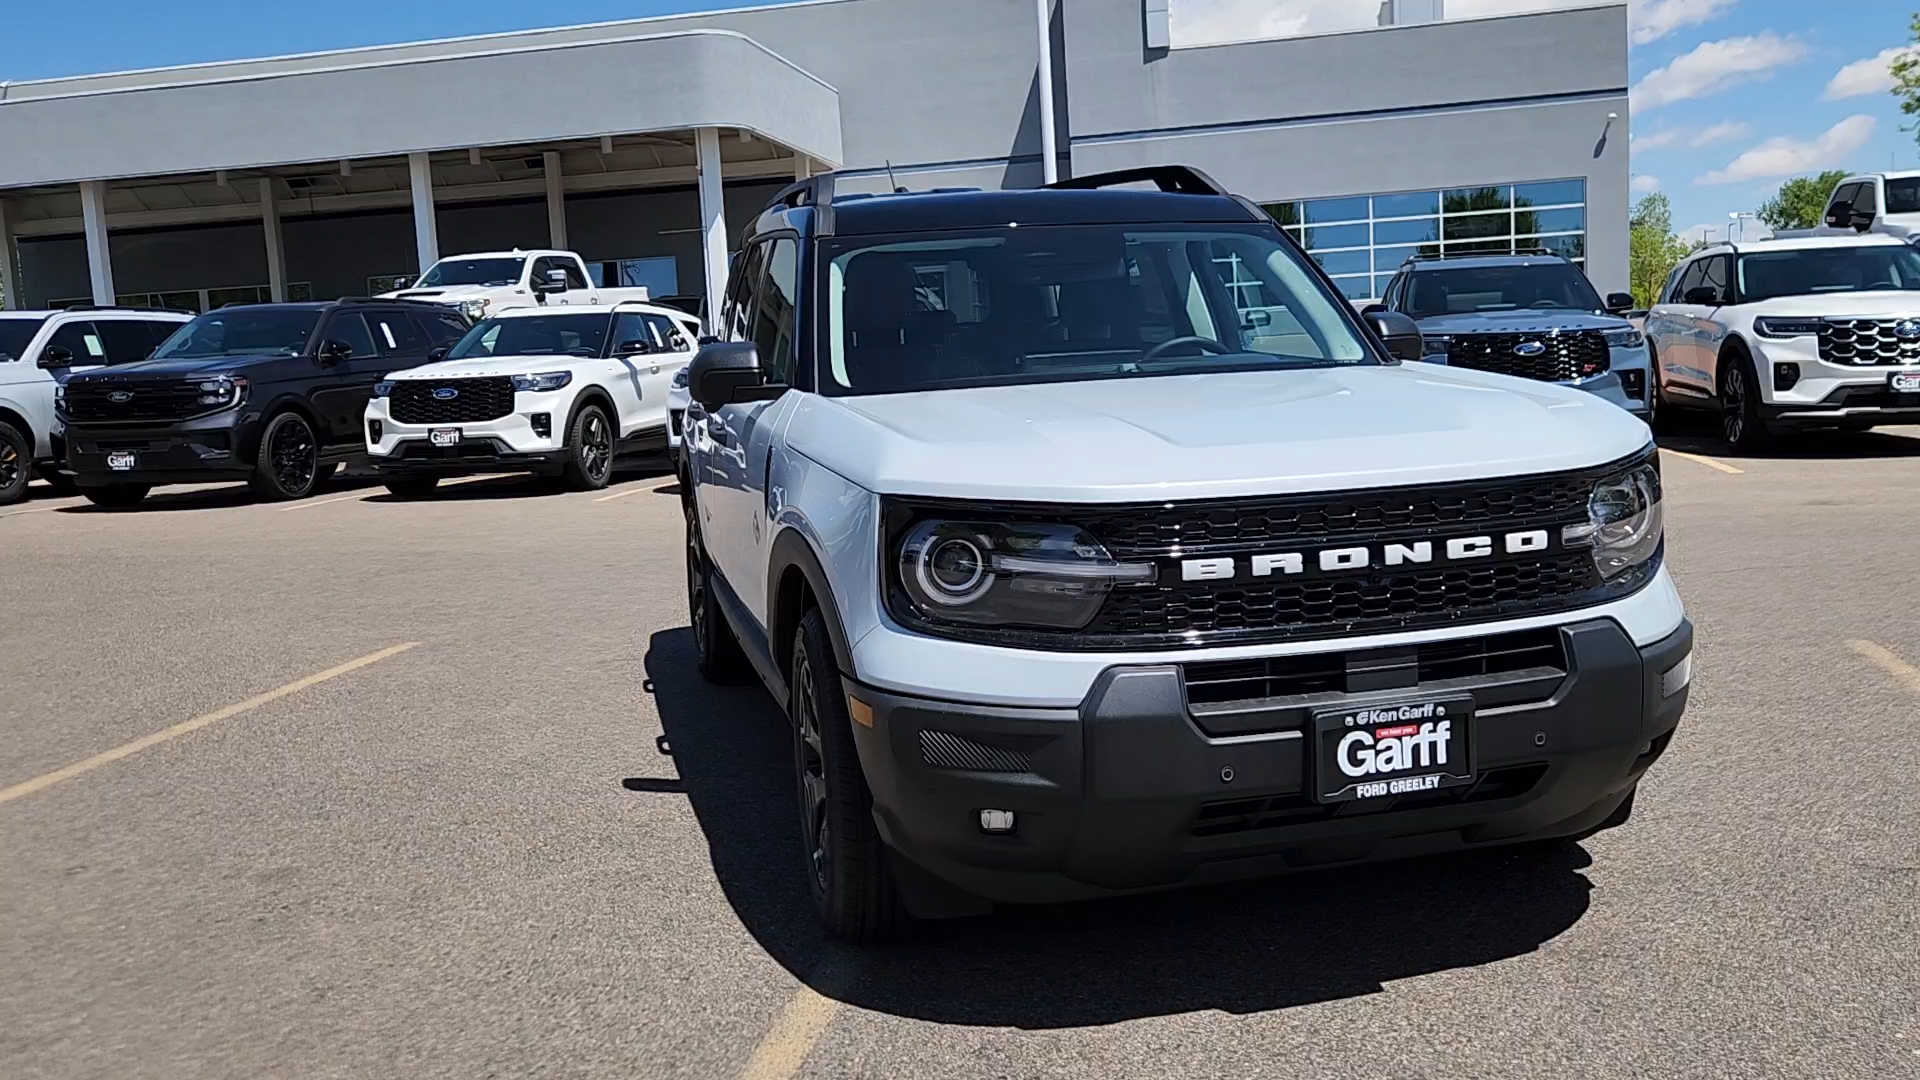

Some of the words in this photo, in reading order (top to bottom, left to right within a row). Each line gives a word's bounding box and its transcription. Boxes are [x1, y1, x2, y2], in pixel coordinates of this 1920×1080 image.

[430, 431, 460, 444] Garff
[107, 455, 135, 467] Garff
[1181, 530, 1548, 581] BRONCO
[1369, 709, 1397, 723] Ken
[1398, 704, 1434, 720] Garff
[1337, 720, 1451, 777] Garff
[1357, 784, 1388, 798] FORD
[1390, 776, 1440, 794] GREELEY
